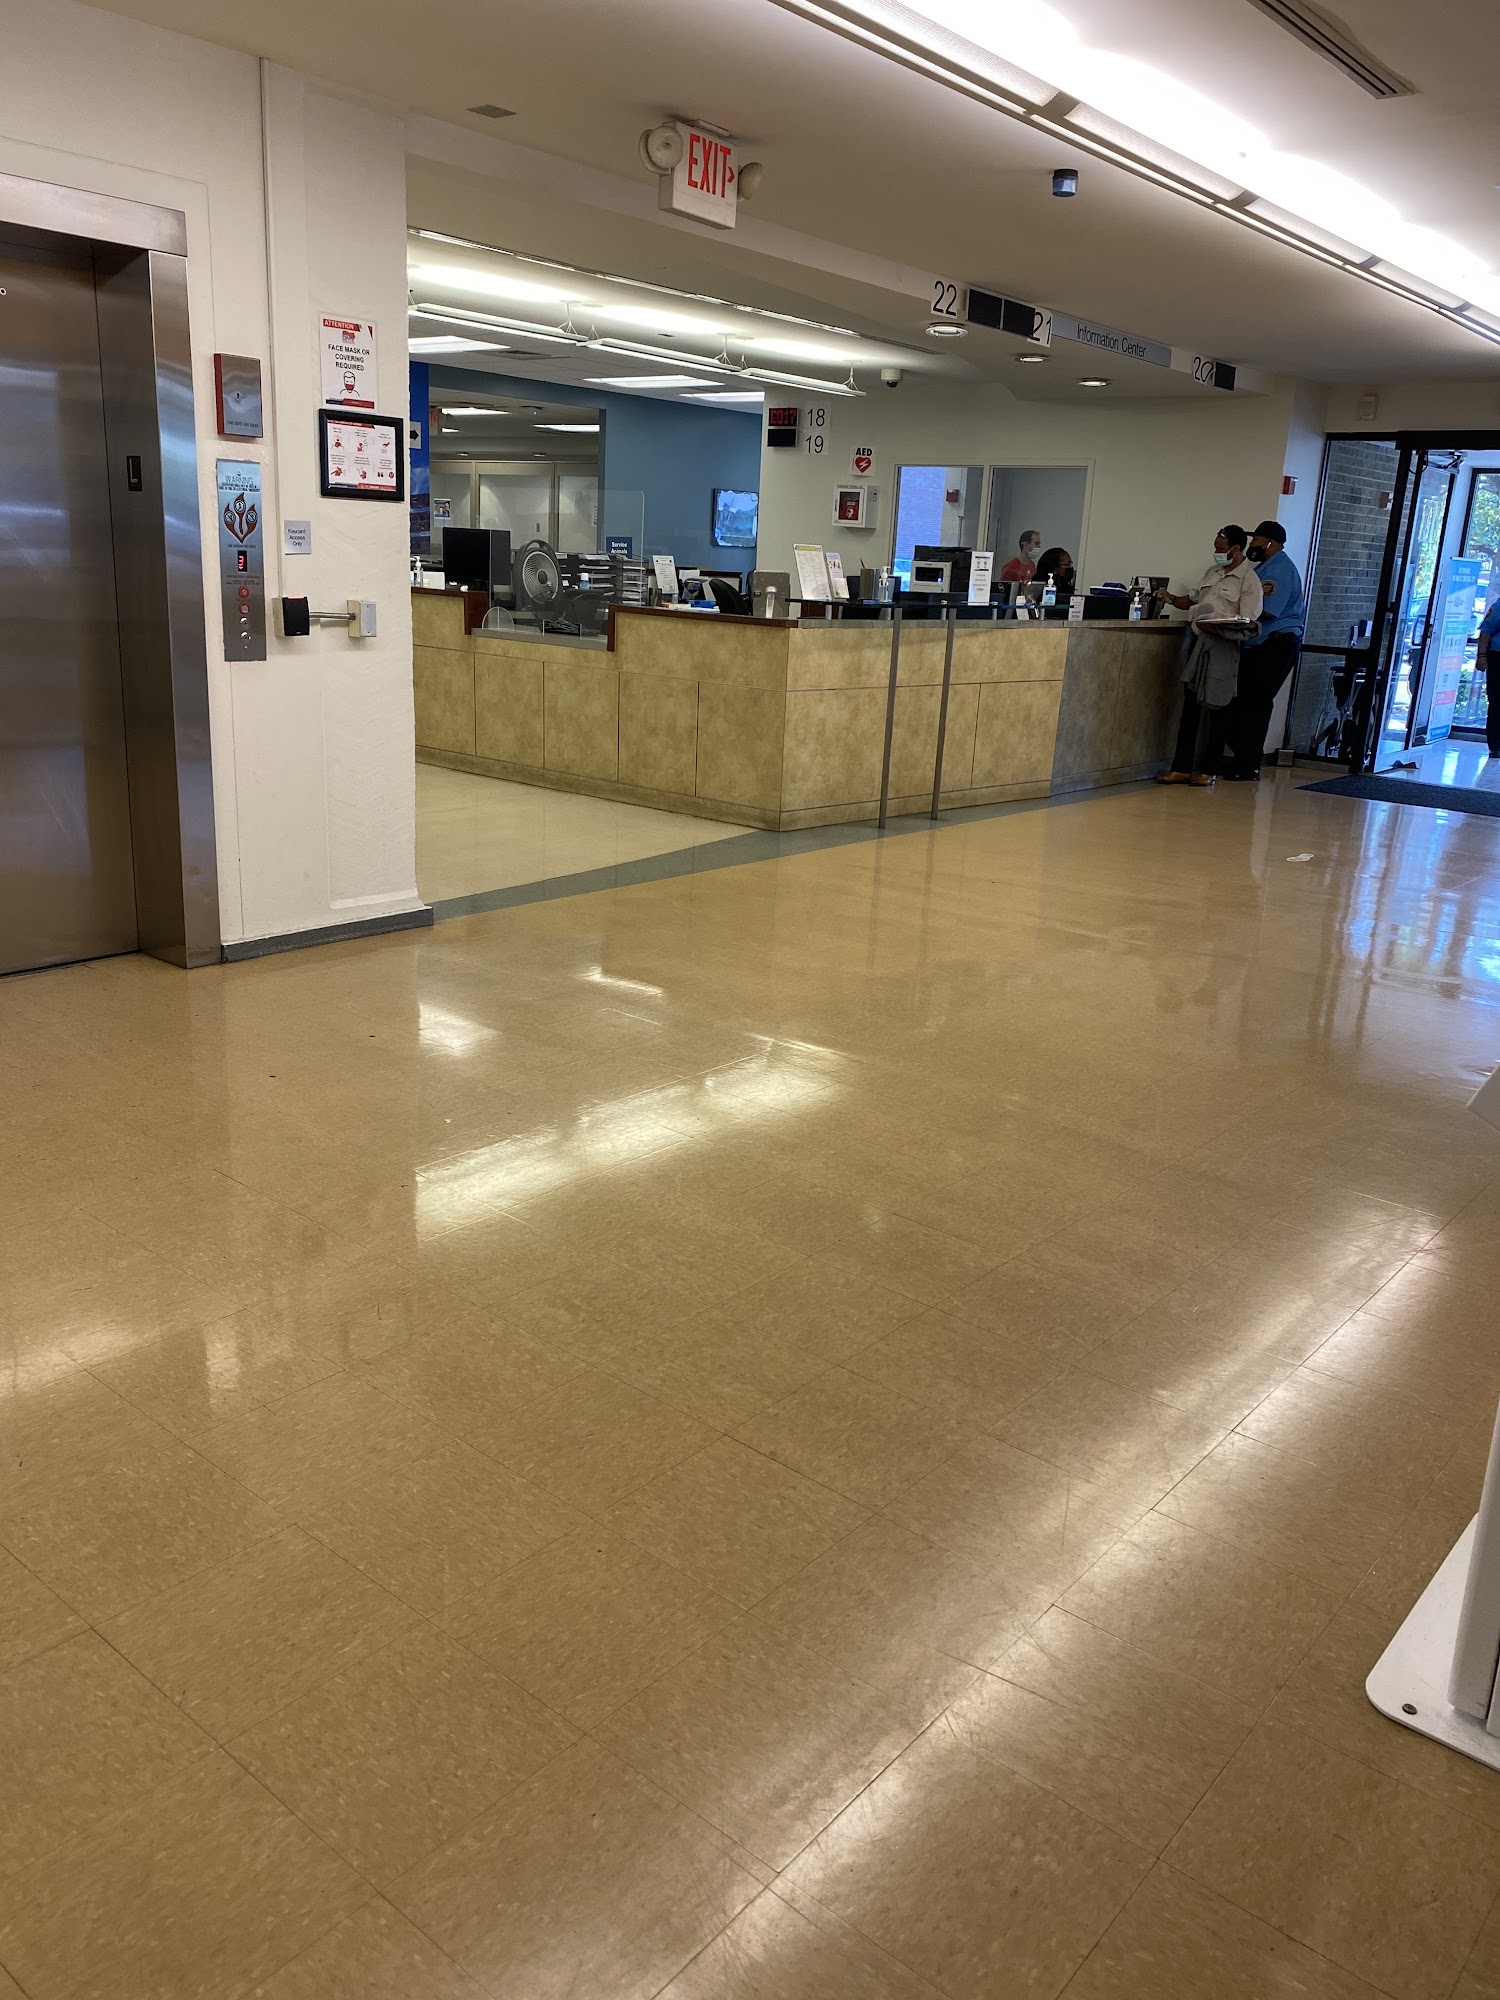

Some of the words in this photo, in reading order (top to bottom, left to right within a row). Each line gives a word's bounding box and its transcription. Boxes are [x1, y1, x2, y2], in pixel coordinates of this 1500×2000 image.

[688, 132, 731, 199] EXIT
[932, 280, 957, 316] 22
[324, 319, 354, 330] ATTENTION
[1029, 312, 1052, 345] 21
[328, 344, 343, 352] FACE
[345, 346, 361, 355] MASK
[362, 348, 371, 356] OR
[1077, 323, 1119, 351] Information
[1121, 337, 1147, 358] Center
[335, 353, 365, 364] COVERING
[335, 361, 365, 372] REQUIRED
[1194, 356, 1214, 383] 20
[807, 408, 825, 427] 18
[805, 435, 824, 454] 19
[855, 447, 872, 456] AED
[292, 540, 303, 548] Only
